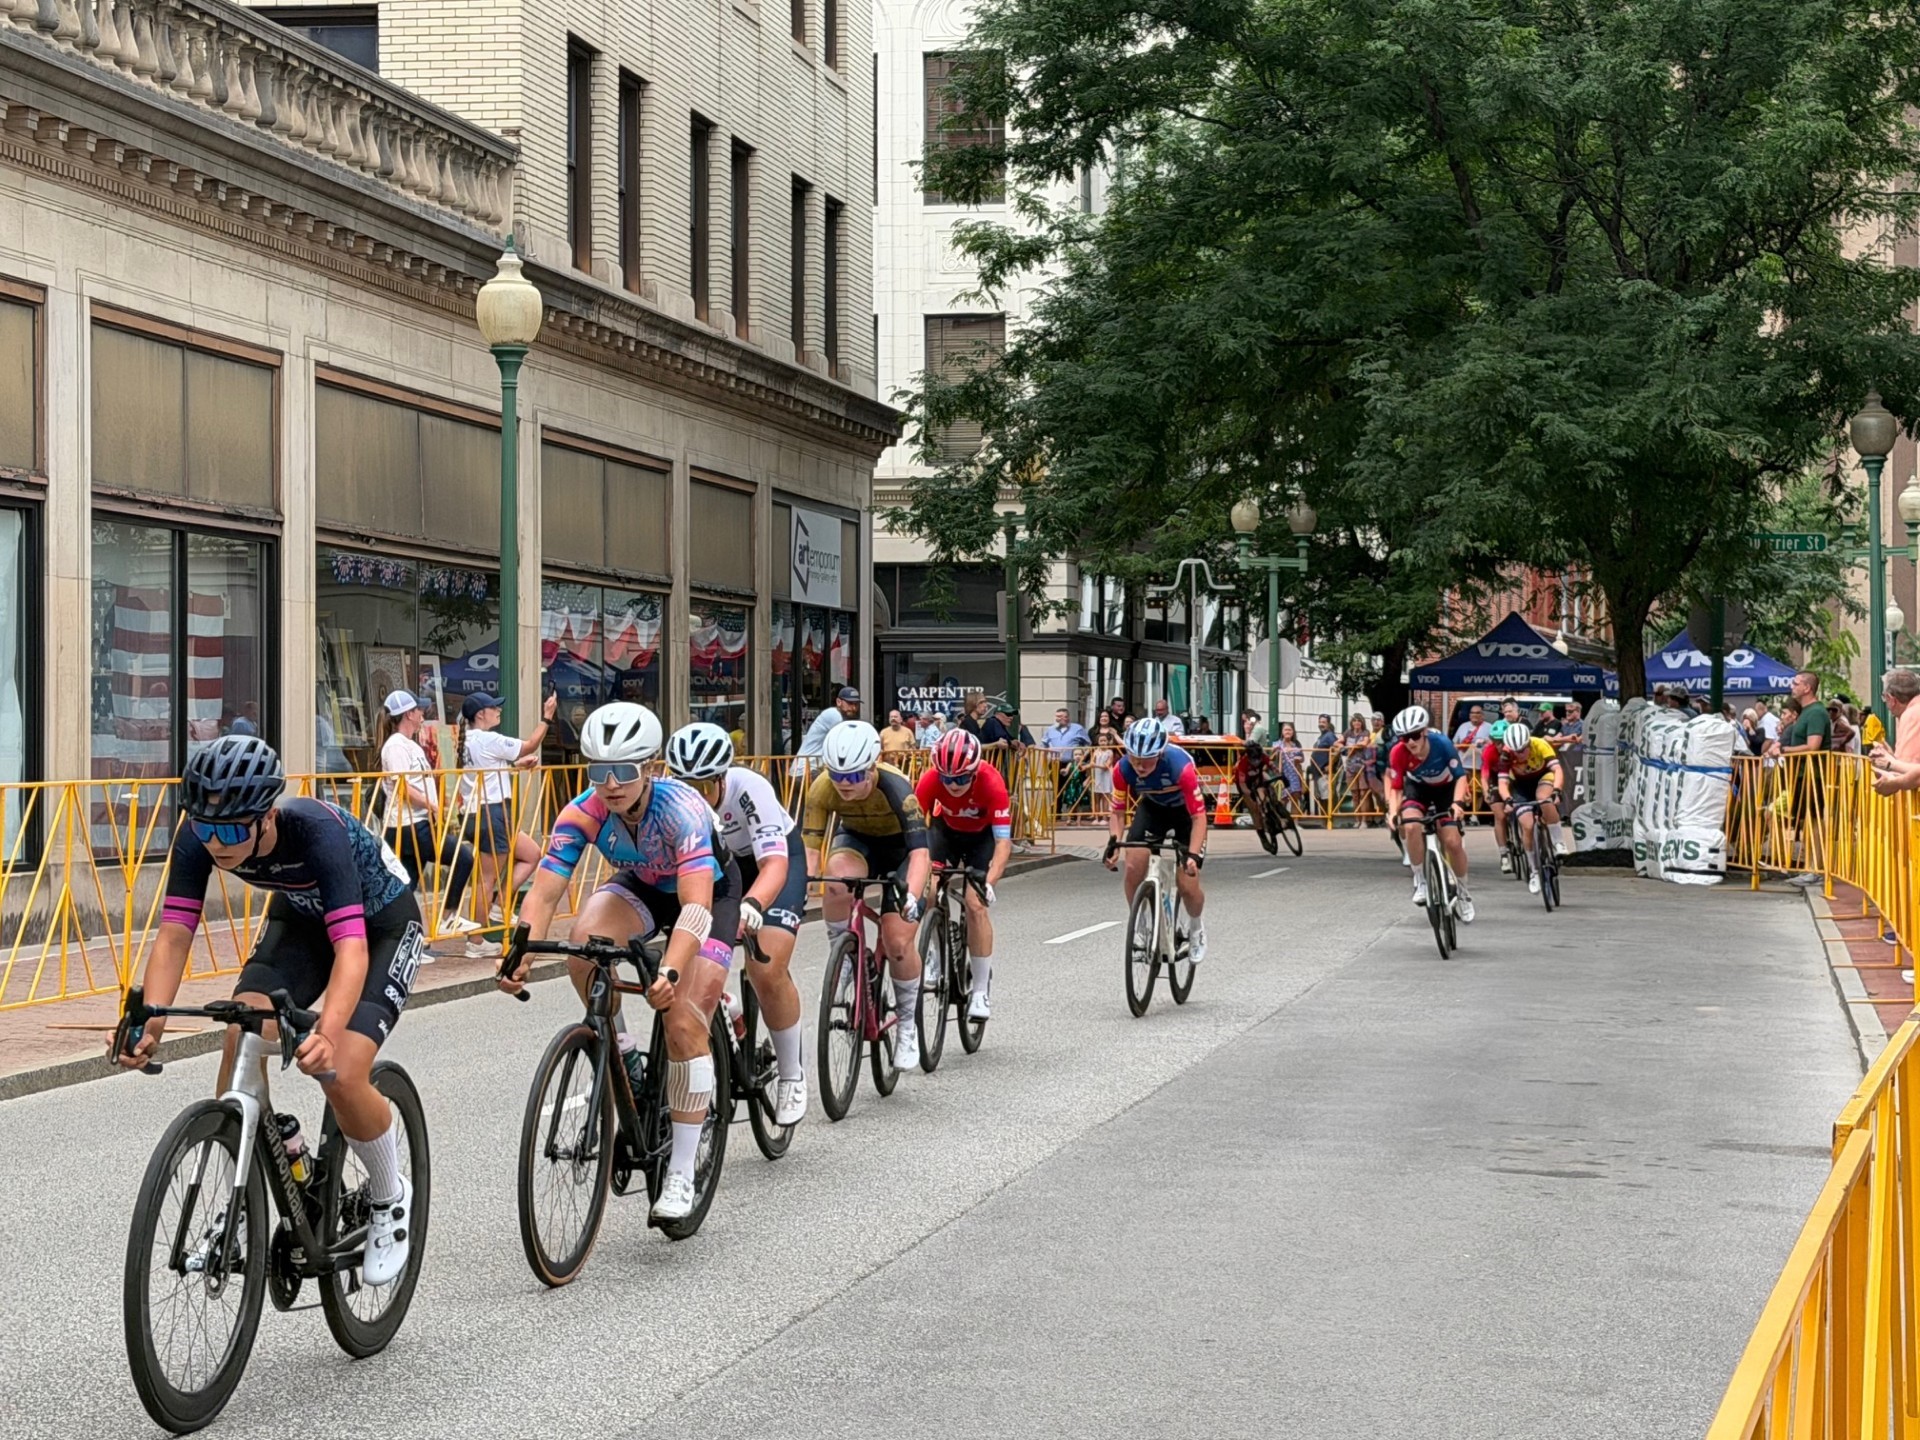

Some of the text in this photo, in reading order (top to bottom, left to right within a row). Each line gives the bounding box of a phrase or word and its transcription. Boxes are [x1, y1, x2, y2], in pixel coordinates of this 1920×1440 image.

[1806, 536, 1820, 550] St
[1477, 642, 1549, 658] V100
[1573, 674, 1596, 685] V100
[898, 700, 951, 712] MARTY
[391, 923, 417, 977] TWENTY
